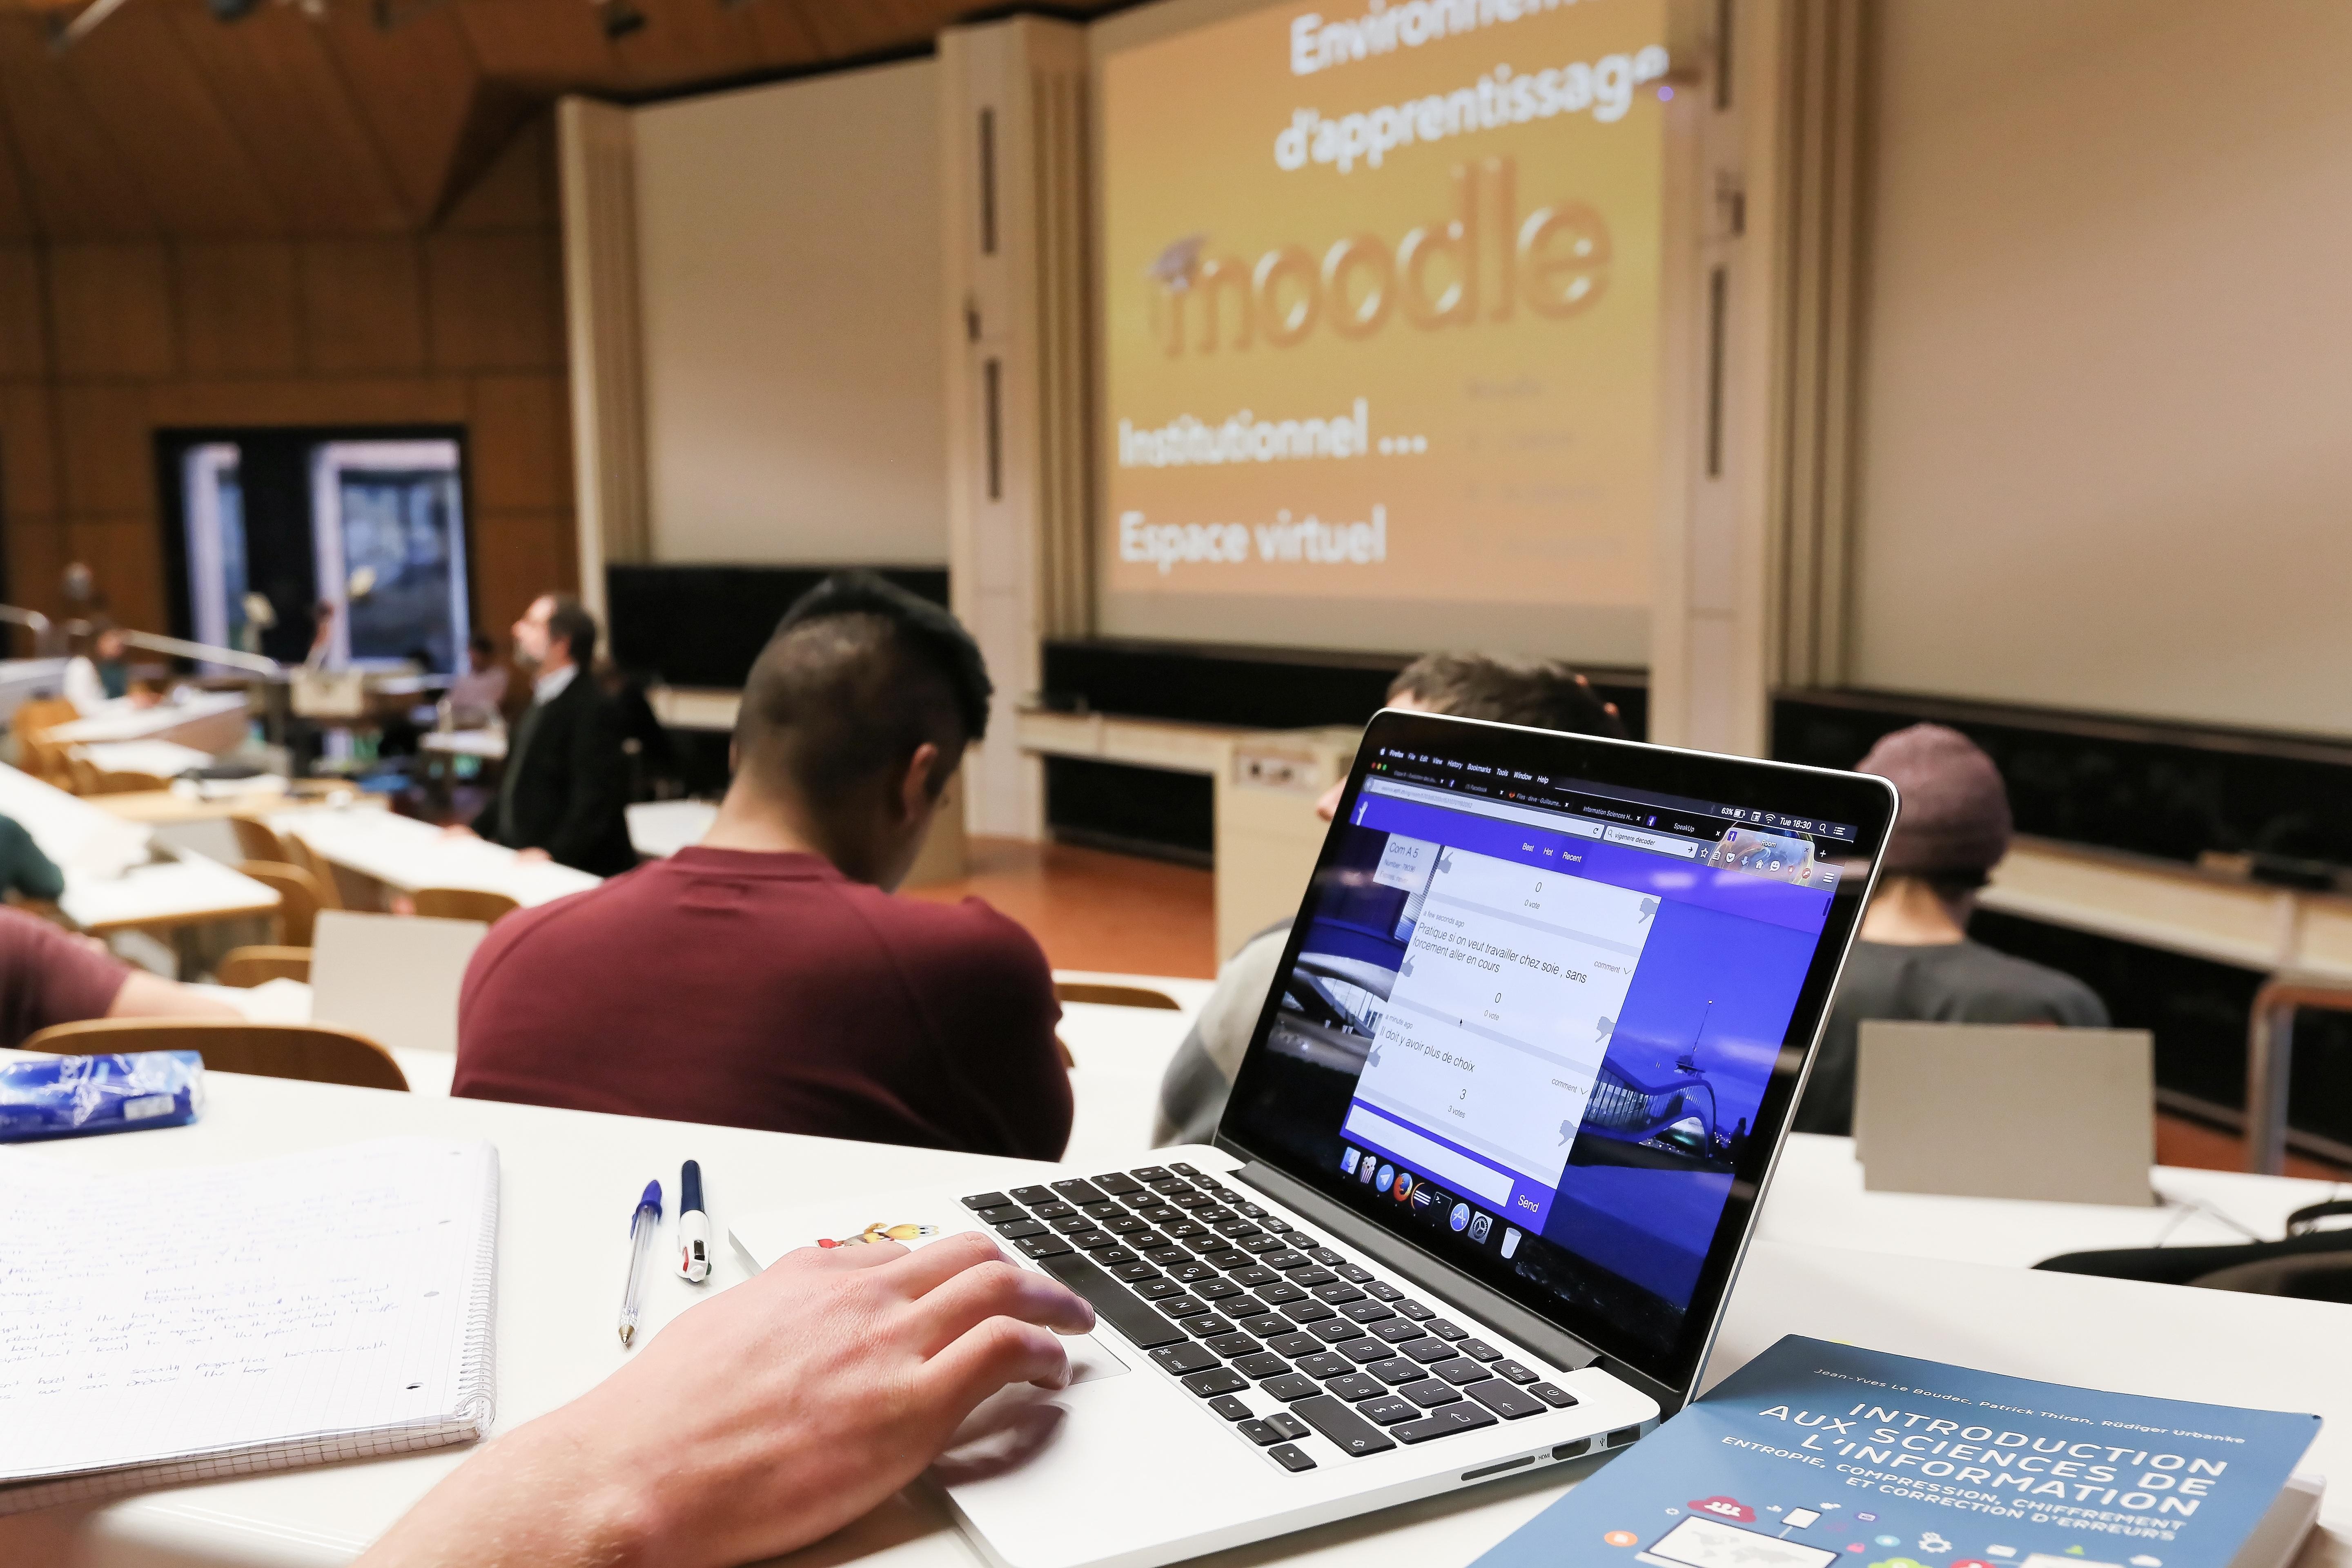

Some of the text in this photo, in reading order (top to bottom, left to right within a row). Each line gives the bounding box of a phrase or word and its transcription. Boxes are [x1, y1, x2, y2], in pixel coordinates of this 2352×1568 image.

[1156, 154, 1613, 359] moodle
[1118, 398, 1368, 468] Institutionnel
[1119, 503, 1386, 575] Espace virtuel
[1447, 760, 1463, 769] History
[1467, 763, 1491, 774] Bookmarks
[1497, 768, 1509, 777] Tools
[1514, 771, 1532, 781] Window
[1537, 775, 1549, 784] Help
[1721, 807, 1733, 815] 63%
[1780, 817, 1792, 826] Tue
[1793, 819, 1812, 829] 18:30
[1583, 805, 1606, 816] Information
[1606, 810, 1626, 819] Sciences
[1673, 823, 1695, 833] SpeakUp
[1615, 832, 1656, 846] vigenere decoder
[1761, 839, 1777, 848] Room
[1390, 842, 1419, 858] Com A 5
[1522, 842, 1582, 862] Best Hot Recent
[1535, 882, 1542, 893] 0
[1529, 901, 1540, 909] vote
[1436, 914, 1455, 925] seconds
[1413, 935, 1500, 973] forcement aller en cours
[1417, 922, 1448, 940] Pratique
[1449, 933, 1457, 942] si
[1457, 936, 1466, 946] on
[1468, 939, 1485, 951] veut
[1485, 943, 1519, 962] travailler
[1520, 954, 1540, 969] chez
[1541, 962, 1559, 975] soie
[1566, 969, 1587, 983] sans
[1594, 960, 1620, 973] comment
[1494, 993, 1501, 1003] 0
[1389, 1016, 1404, 1025] minute
[1489, 1012, 1499, 1021] vote
[1380, 1025, 1475, 1073] Il doit y avoir plus de choix
[1552, 1078, 1578, 1093] comment
[1460, 1089, 1467, 1100] 3
[1452, 1108, 1466, 1118] votes
[1518, 1194, 1540, 1213] Send
[1813, 1368, 2246, 1444] Jean-Yves Le Boudec, Patrick Thiran, Rüdiger Urbanke
[1849, 1403, 2228, 1477] INTRODUCTION
[1538, 1452, 1551, 1461] HDMI
[1758, 1405, 2217, 1497] AUX SCIENCES DE
[1721, 1435, 2187, 1531] ENTROPIE, COMPRESSION, CHIFFREMENT
[1800, 1433, 2201, 1517] L'INFORMATION
[1845, 1477, 2176, 1541] ET CORRECTION D'ERREURS
